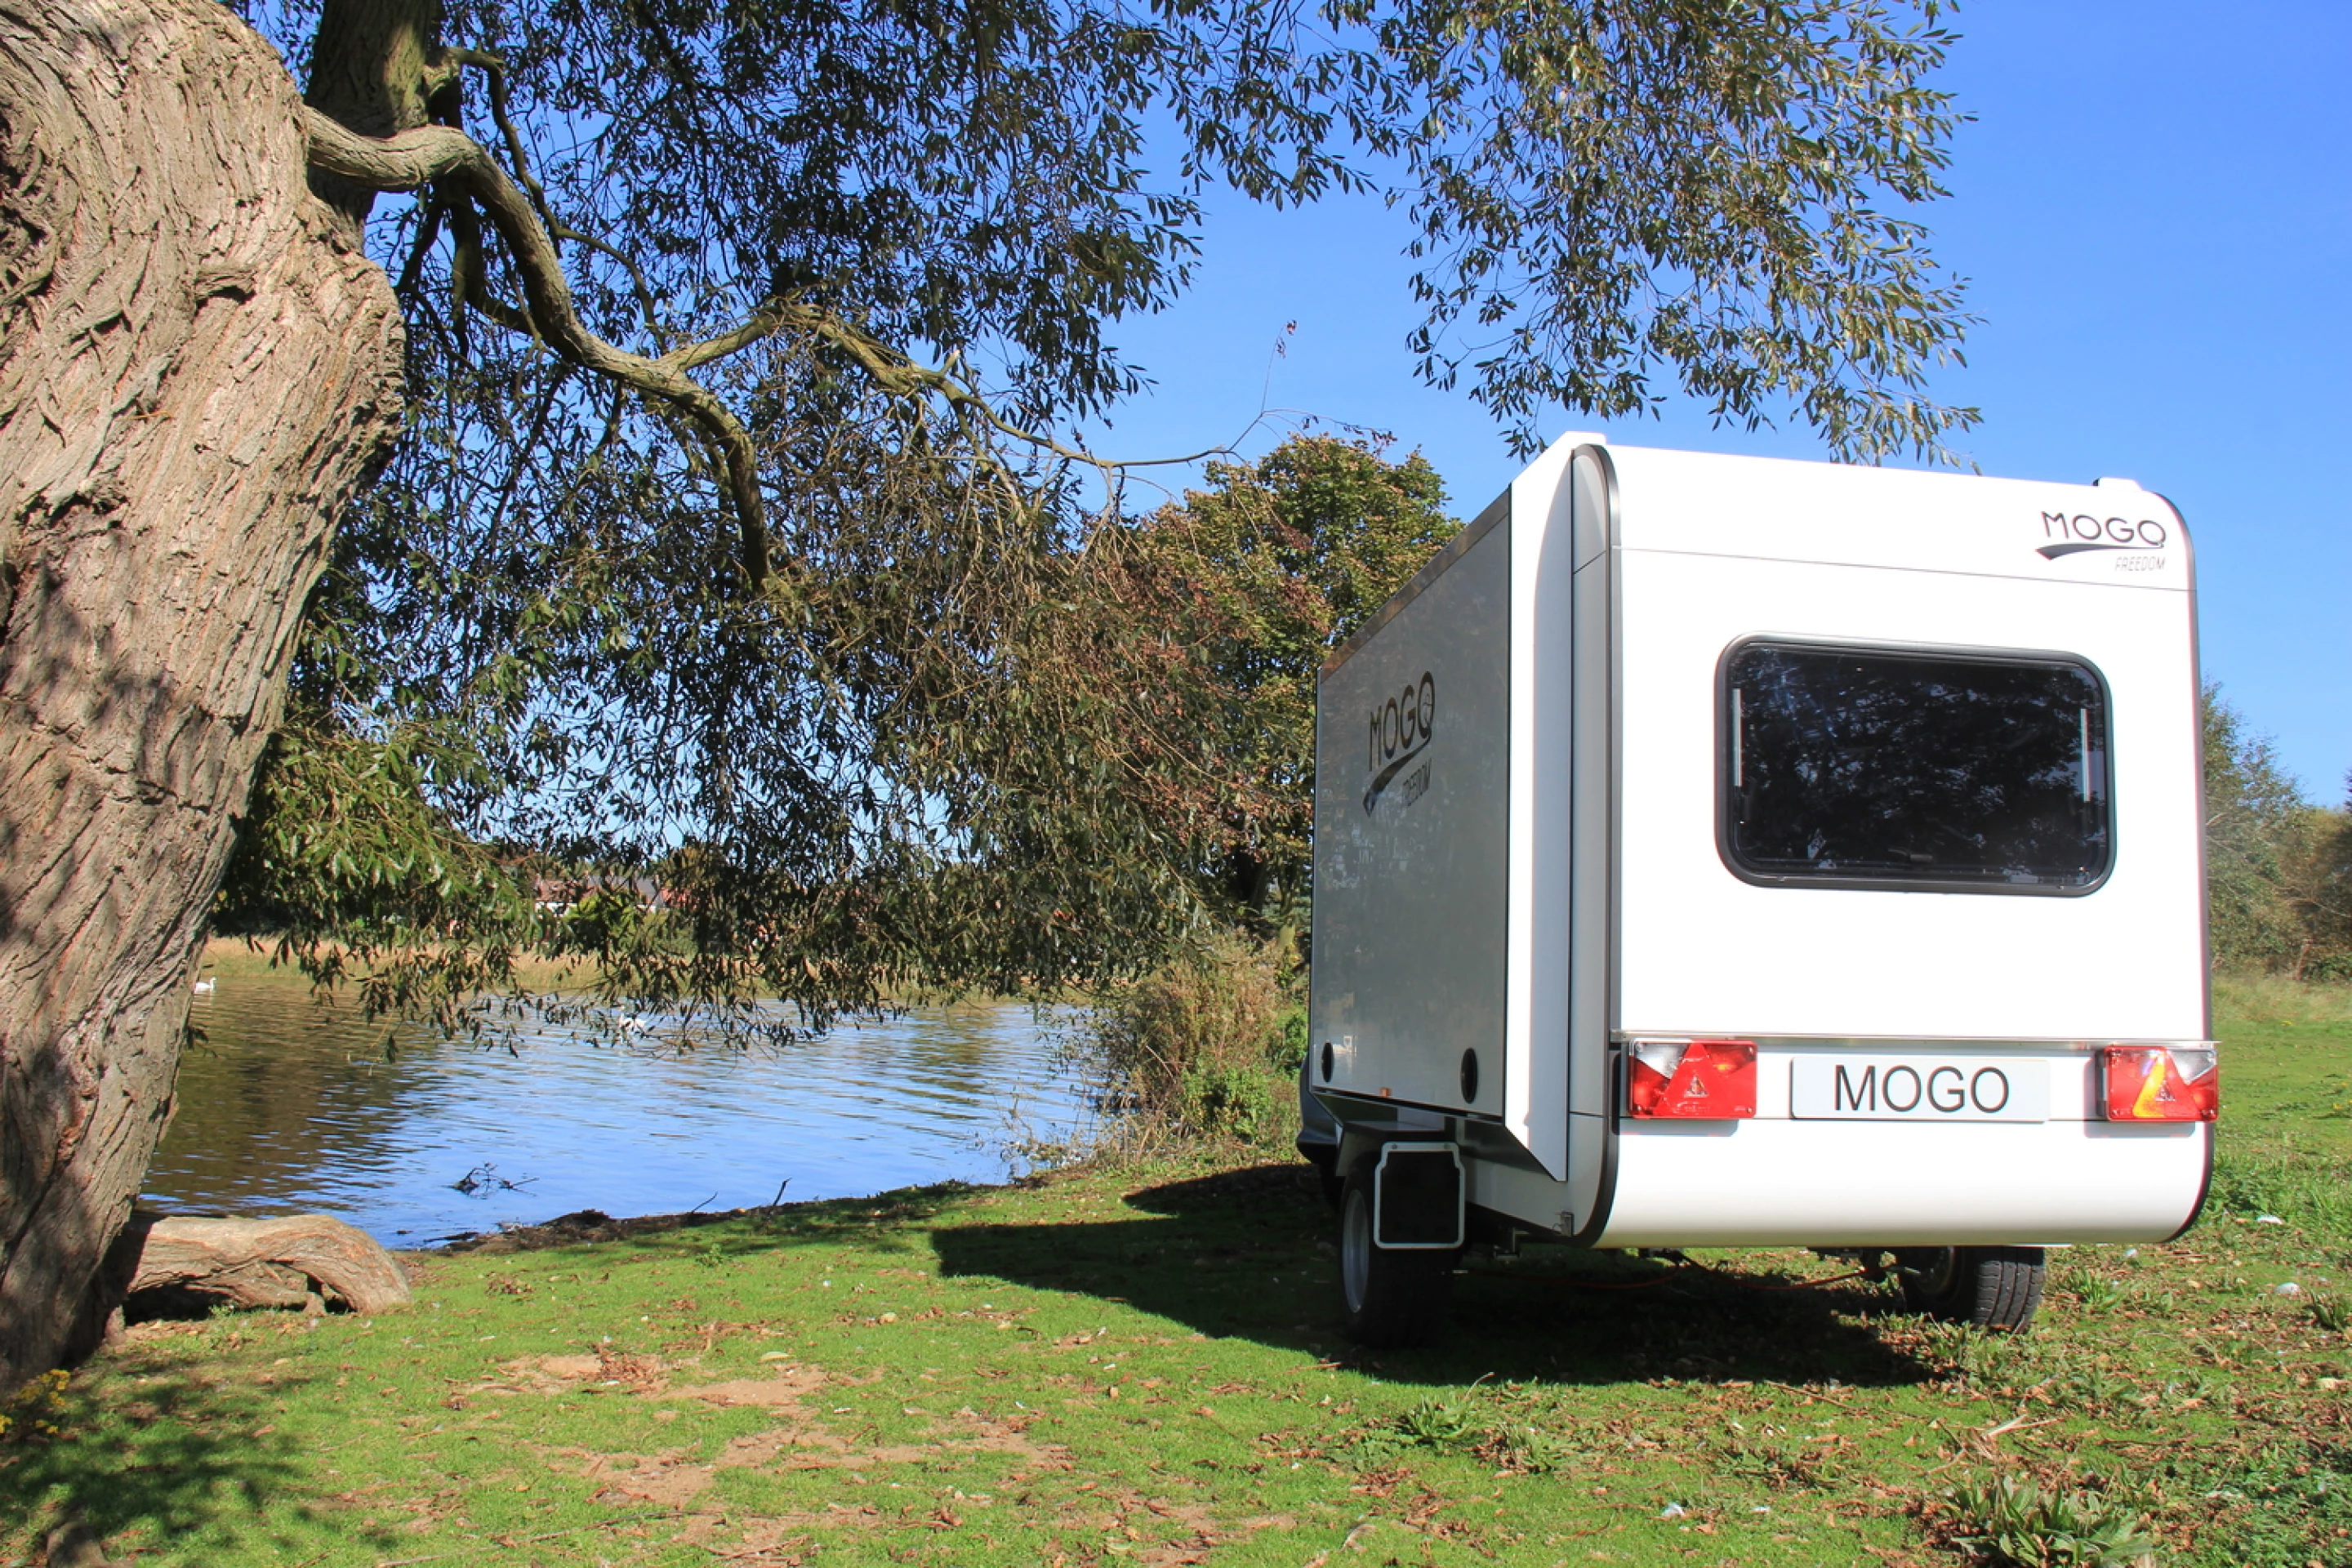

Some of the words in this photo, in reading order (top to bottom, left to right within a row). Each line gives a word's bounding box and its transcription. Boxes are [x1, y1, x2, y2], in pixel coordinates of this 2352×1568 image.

[2041, 510, 2166, 546] MOGO
[2115, 556, 2166, 571] FREEDOM
[1369, 670, 1435, 772] MOGO
[1834, 1064, 2009, 1114] MOGO
